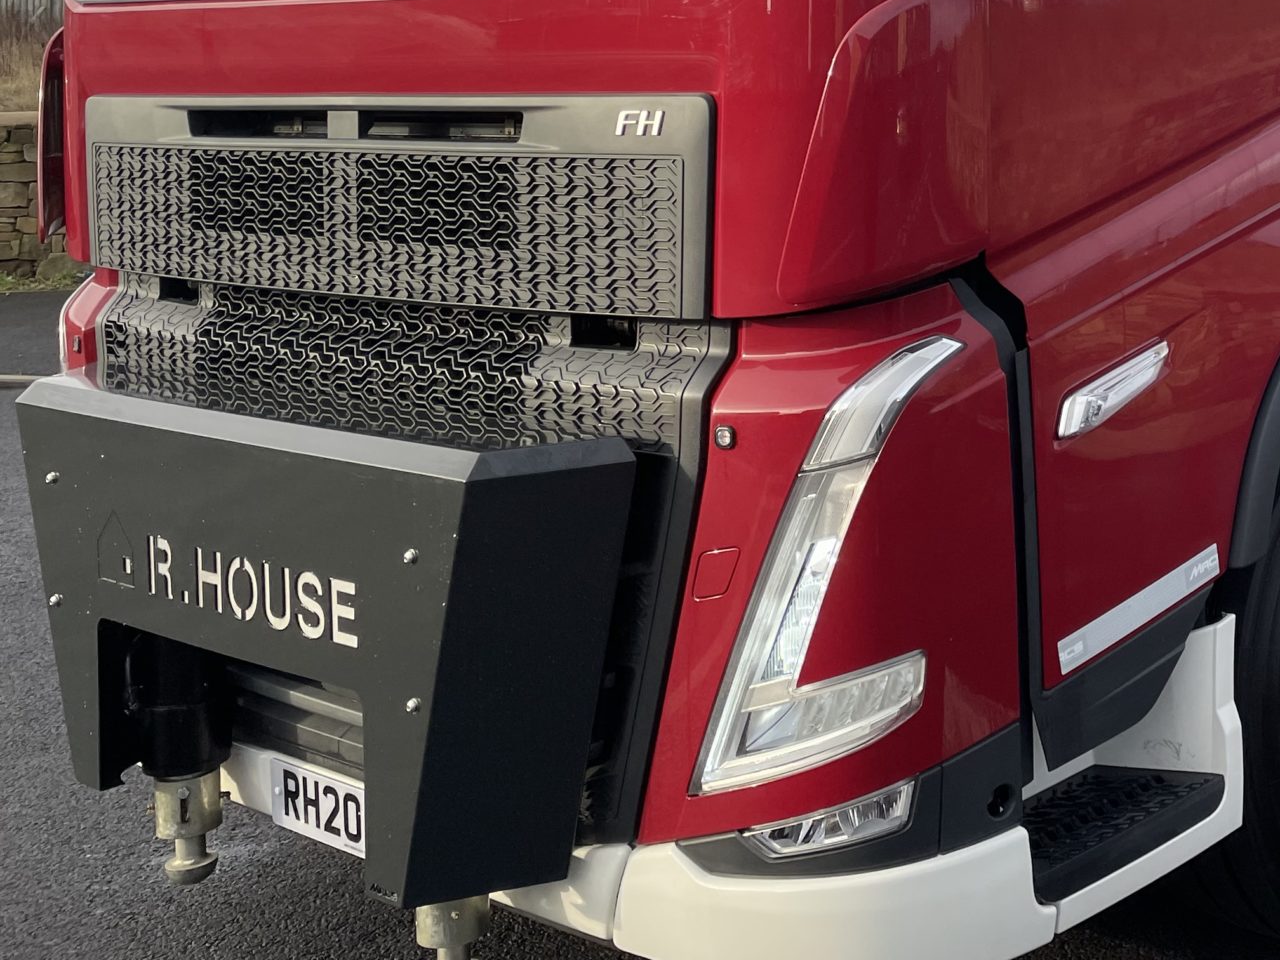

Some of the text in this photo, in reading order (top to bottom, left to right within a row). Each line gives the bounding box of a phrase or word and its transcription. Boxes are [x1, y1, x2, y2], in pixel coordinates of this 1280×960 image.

[615, 109, 665, 137] FH
[147, 534, 359, 649] R.HOUSE
[282, 768, 363, 845] RH20
